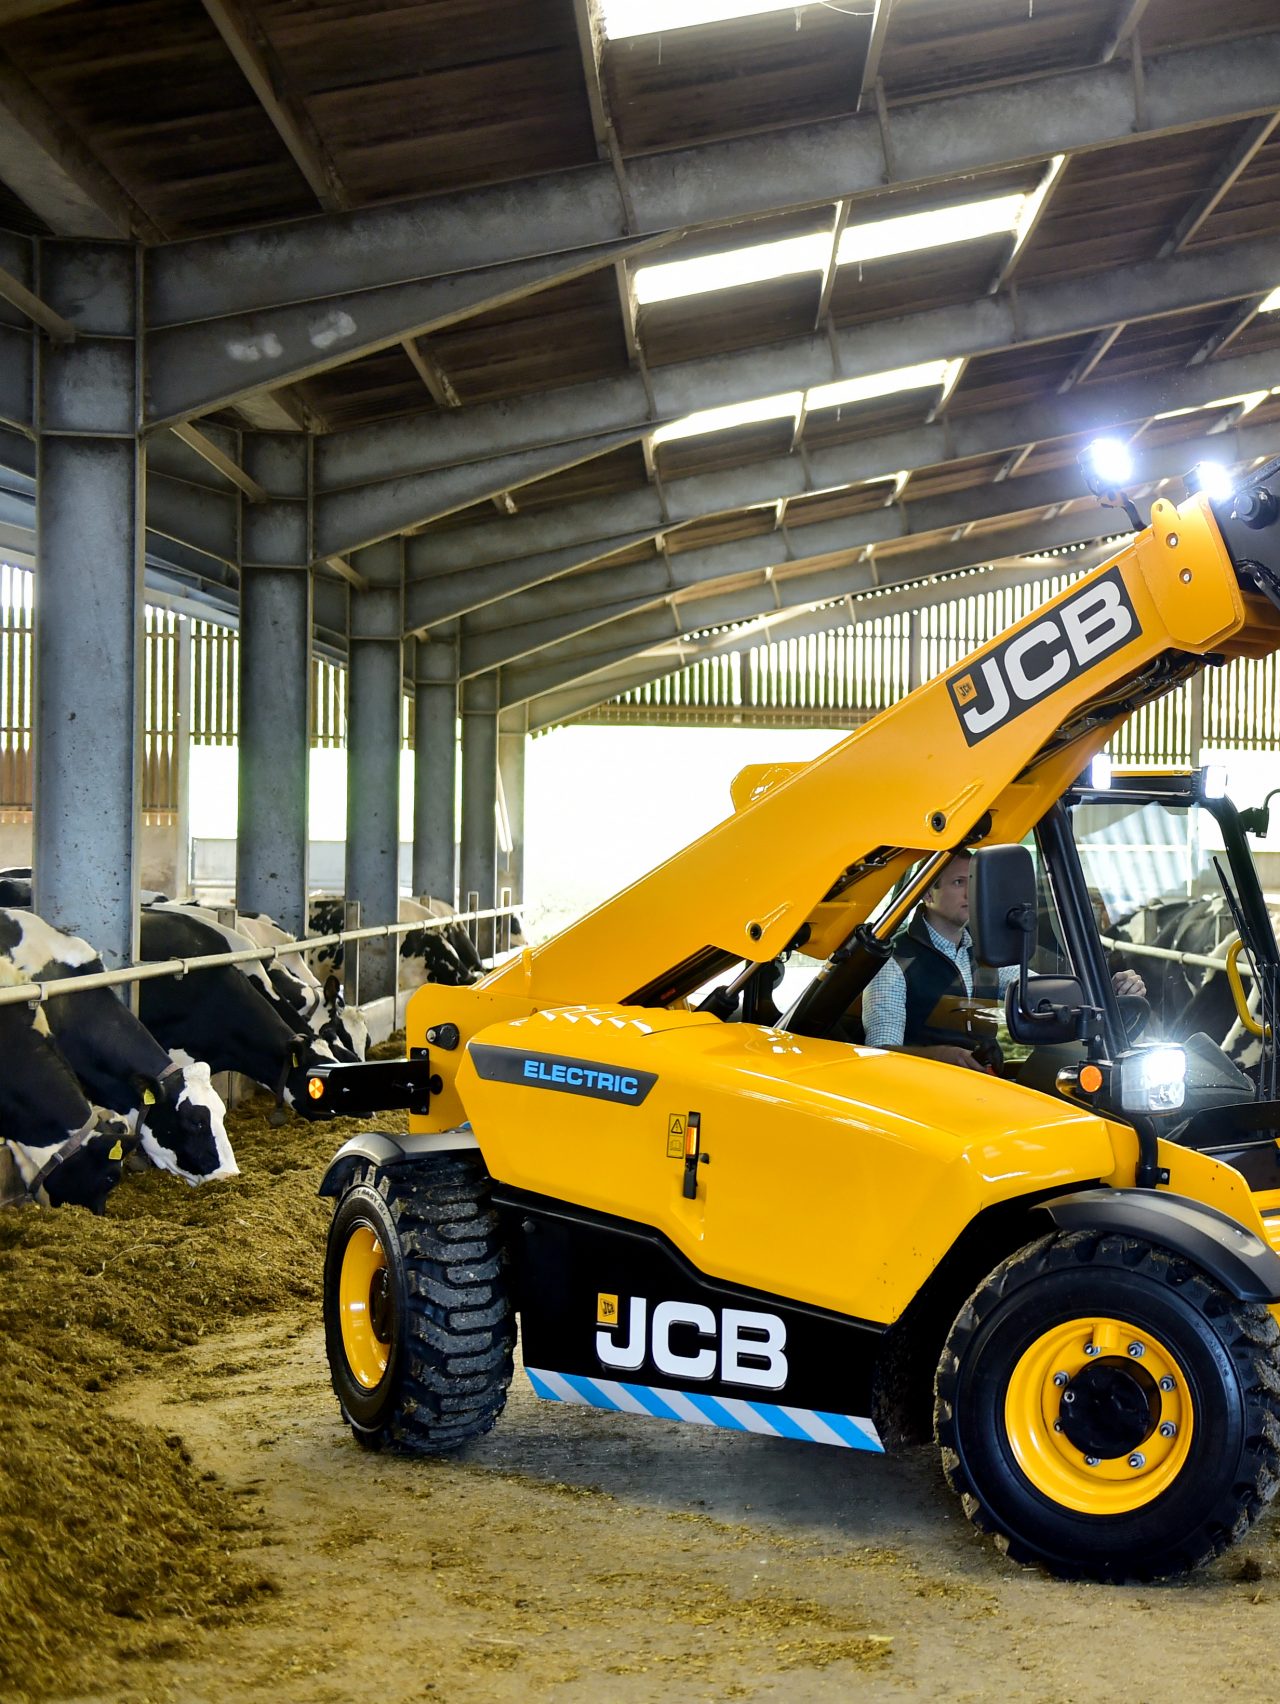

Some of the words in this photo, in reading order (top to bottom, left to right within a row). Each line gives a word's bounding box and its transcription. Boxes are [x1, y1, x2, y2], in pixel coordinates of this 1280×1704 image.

[963, 581, 1132, 734] JCB
[524, 1060, 638, 1095] ELECTRIC
[596, 1296, 789, 1389] JCB
